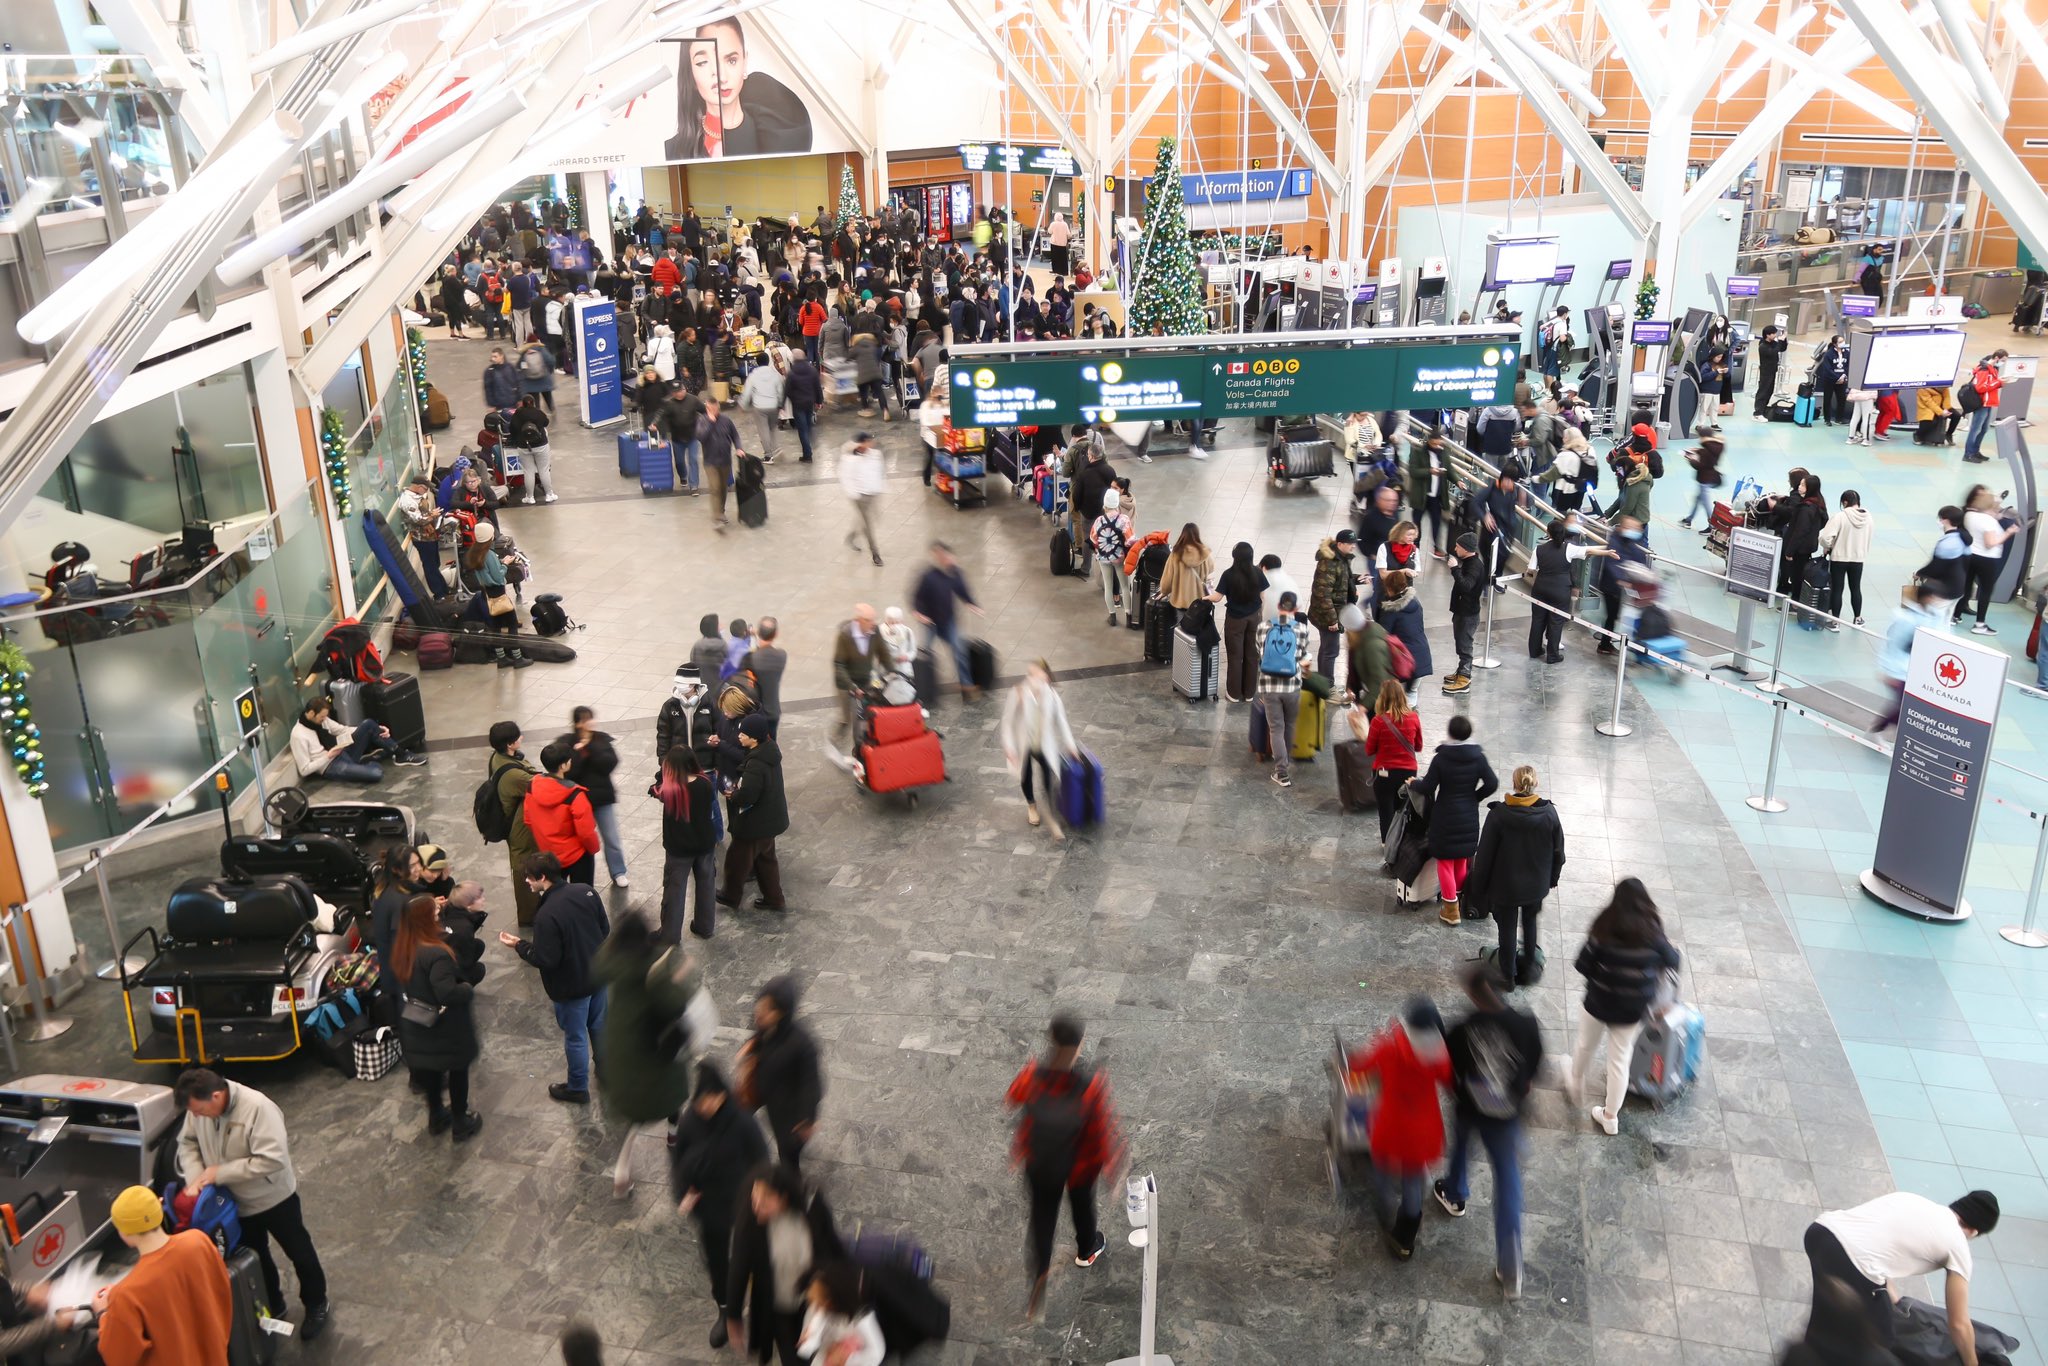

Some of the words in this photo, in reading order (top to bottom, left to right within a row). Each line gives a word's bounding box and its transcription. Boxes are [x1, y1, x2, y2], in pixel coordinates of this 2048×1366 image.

[592, 154, 626, 164] STREET
[587, 313, 613, 326] EXPRESS
[1255, 363, 1264, 372] A
[1272, 362, 1280, 371] B
[1287, 361, 1297, 371] C
[1225, 379, 1262, 388] Canada
[1264, 377, 1296, 388] Flights
[1412, 382, 1433, 392] Aire
[976, 401, 1001, 411] Train
[1036, 398, 1057, 410] ville
[1921, 683, 1935, 693] AIR
[1935, 689, 1973, 707] CANADA
[1907, 708, 1938, 727] ECONOMY
[1937, 721, 1959, 735] CLASS
[1906, 717, 1926, 732] CLASSE
[1925, 726, 1972, 749] ÉCONOMIQUE
[1913, 744, 1939, 760] International
[1911, 756, 1926, 767] Canada
[1889, 879, 1901, 889] STAR
[1901, 885, 1926, 901] ALLIANCE
